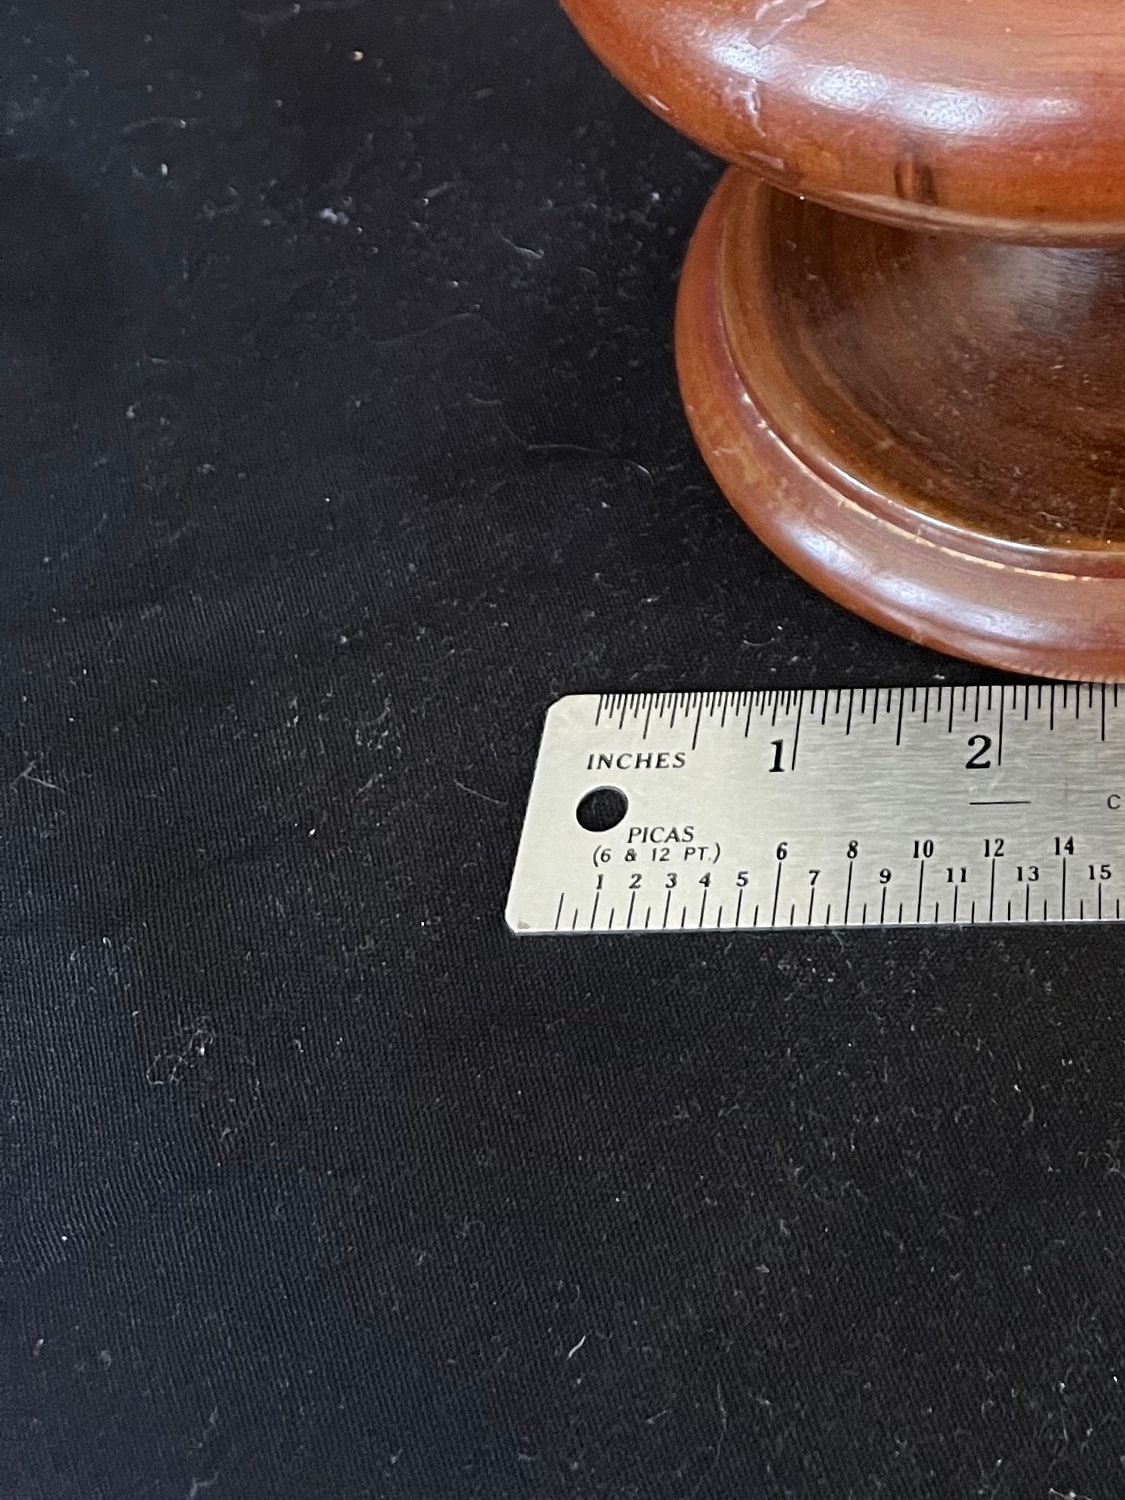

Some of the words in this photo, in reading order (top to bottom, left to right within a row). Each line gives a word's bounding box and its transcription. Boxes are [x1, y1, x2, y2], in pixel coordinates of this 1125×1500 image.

[586, 752, 687, 770] INCHES
[768, 739, 786, 773] 1
[965, 734, 992, 769] 2
[627, 826, 695, 843] PICAS
[592, 845, 612, 867] (6
[624, 848, 638, 862] &
[651, 848, 670, 862] 12
[683, 842, 721, 864] PT.)
[776, 842, 788, 861] 6
[846, 840, 859, 859] 8
[912, 839, 934, 859] 10
[984, 838, 1005, 858] 12
[1054, 836, 1075, 856] 14
[596, 874, 603, 890] 1
[629, 873, 642, 889] 2
[665, 873, 678, 888] 3
[699, 872, 712, 888] 4
[736, 871, 749, 887] 5
[808, 870, 821, 886] 7
[879, 869, 892, 884] 9
[946, 868, 968, 882] 11
[1016, 866, 1039, 882] 13
[1088, 865, 1112, 880] 15
